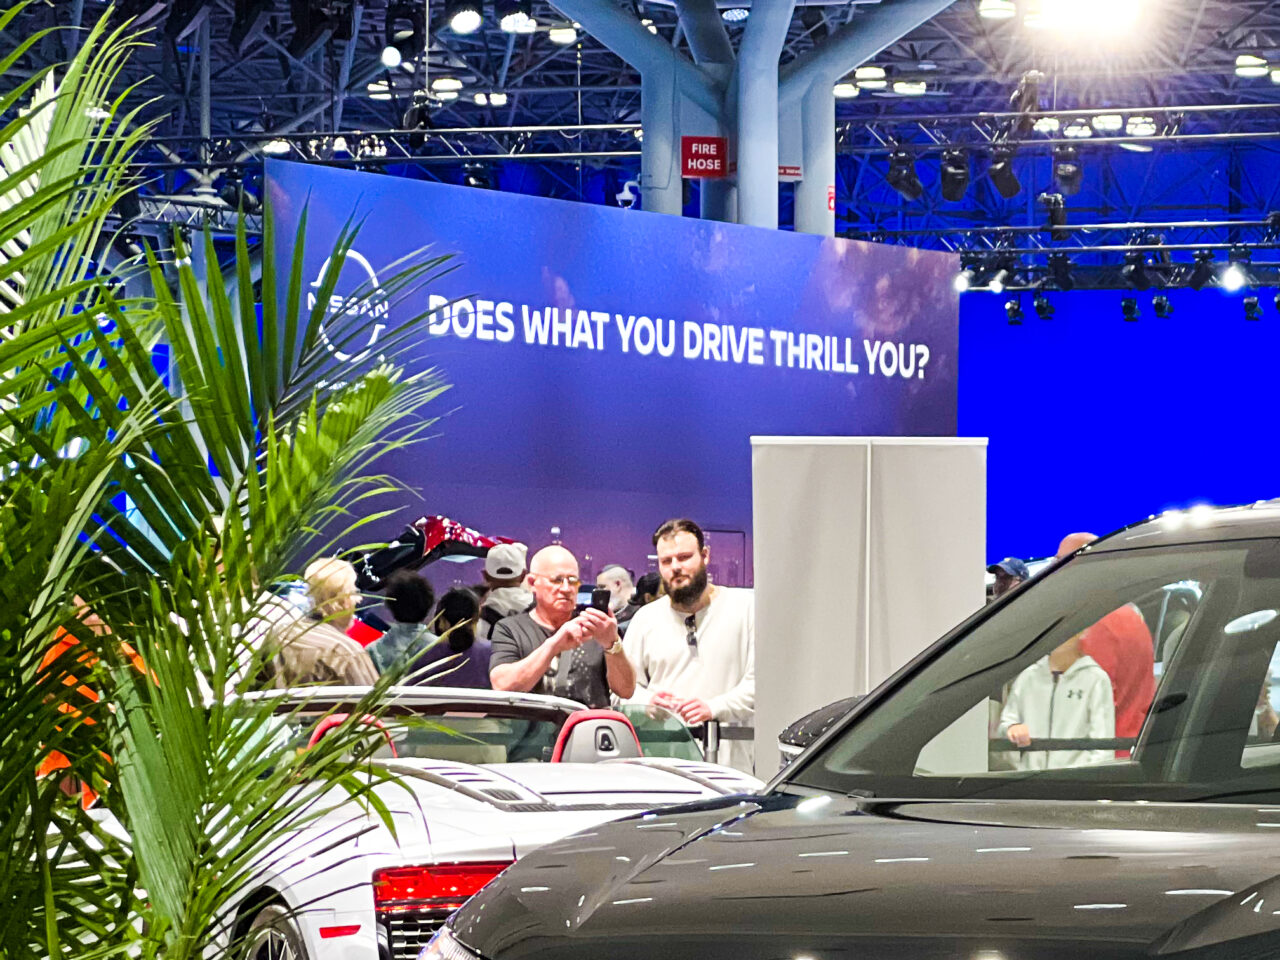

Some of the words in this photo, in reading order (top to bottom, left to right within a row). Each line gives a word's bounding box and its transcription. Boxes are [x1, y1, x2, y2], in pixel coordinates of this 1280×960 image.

[691, 143, 717, 155] FIRE
[688, 158, 721, 170] HOSE
[428, 294, 515, 343] DOES
[521, 304, 610, 351] WHAT
[615, 314, 676, 357] YOU
[683, 320, 765, 365] DRIVE
[769, 329, 859, 374] THRILL
[863, 339, 930, 378] YOU?
